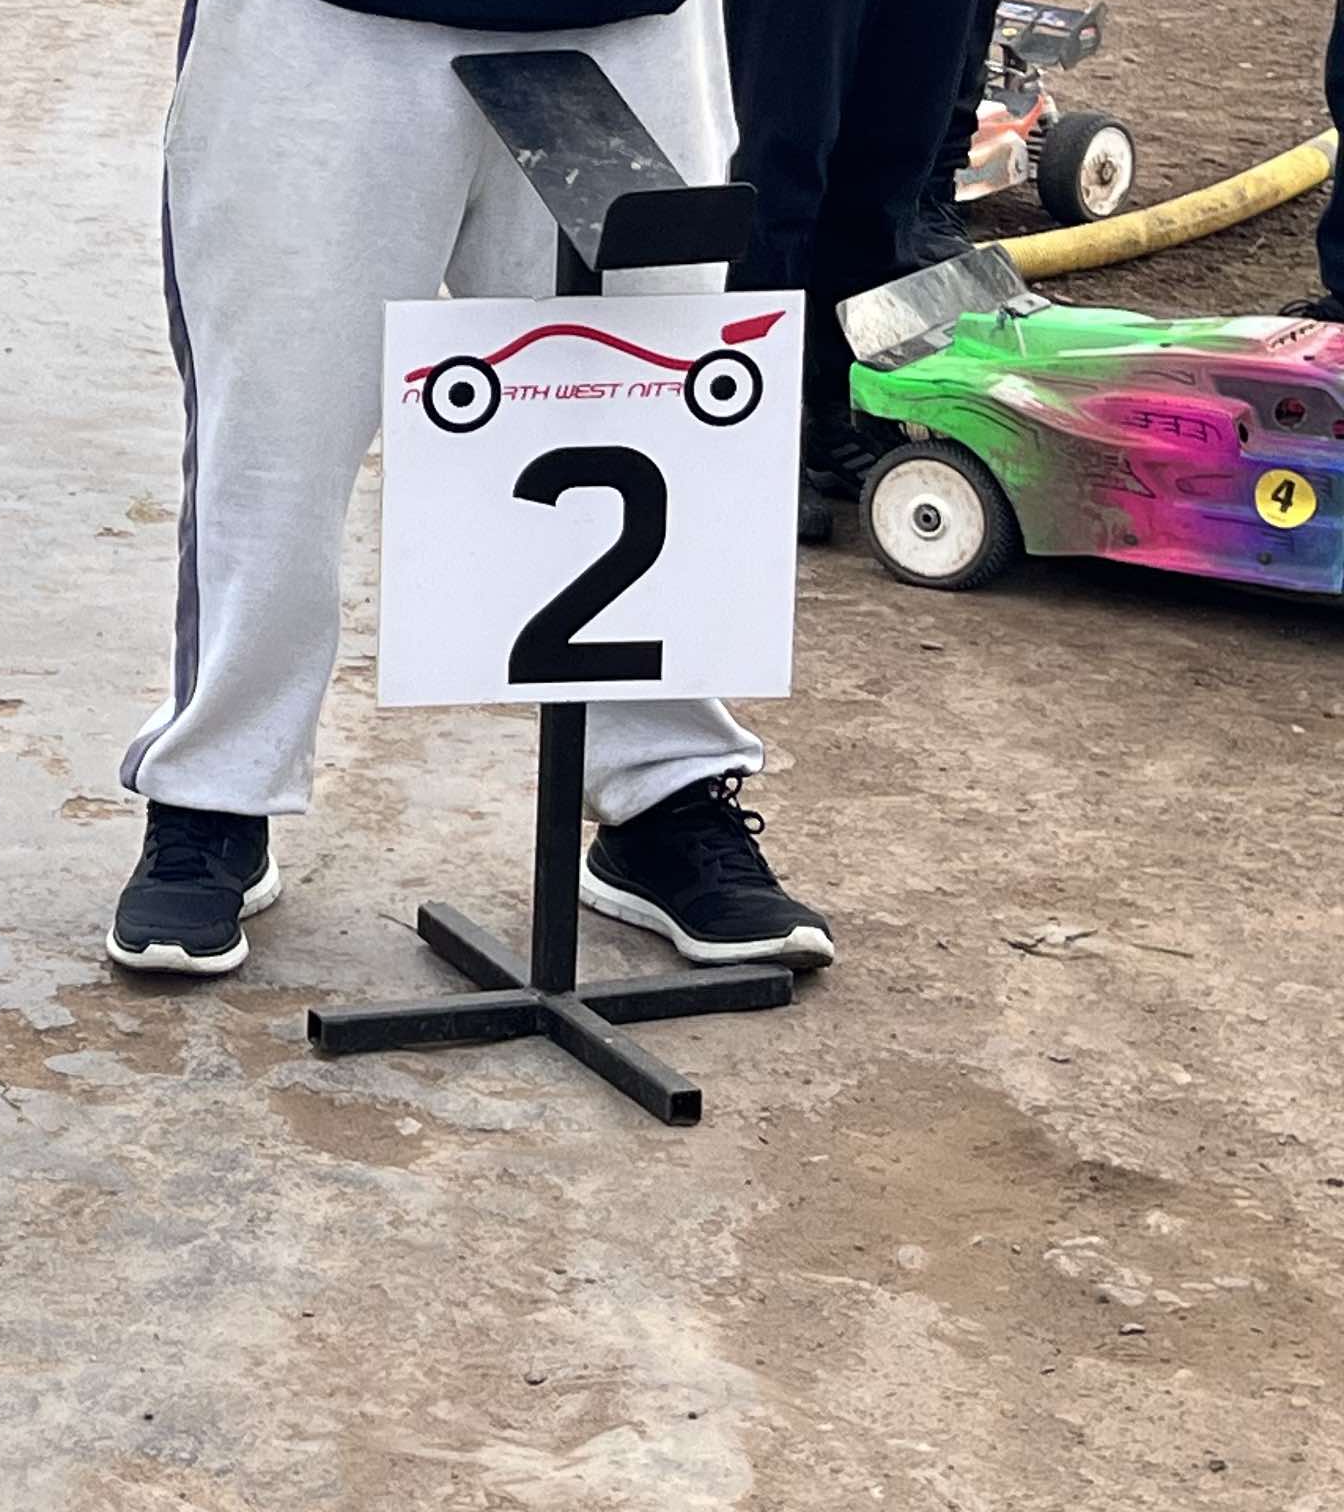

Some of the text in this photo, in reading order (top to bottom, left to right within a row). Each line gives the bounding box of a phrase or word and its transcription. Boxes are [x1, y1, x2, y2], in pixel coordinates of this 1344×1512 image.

[555, 382, 621, 400] WEST
[1271, 479, 1296, 513] 4
[508, 445, 668, 685] 2
